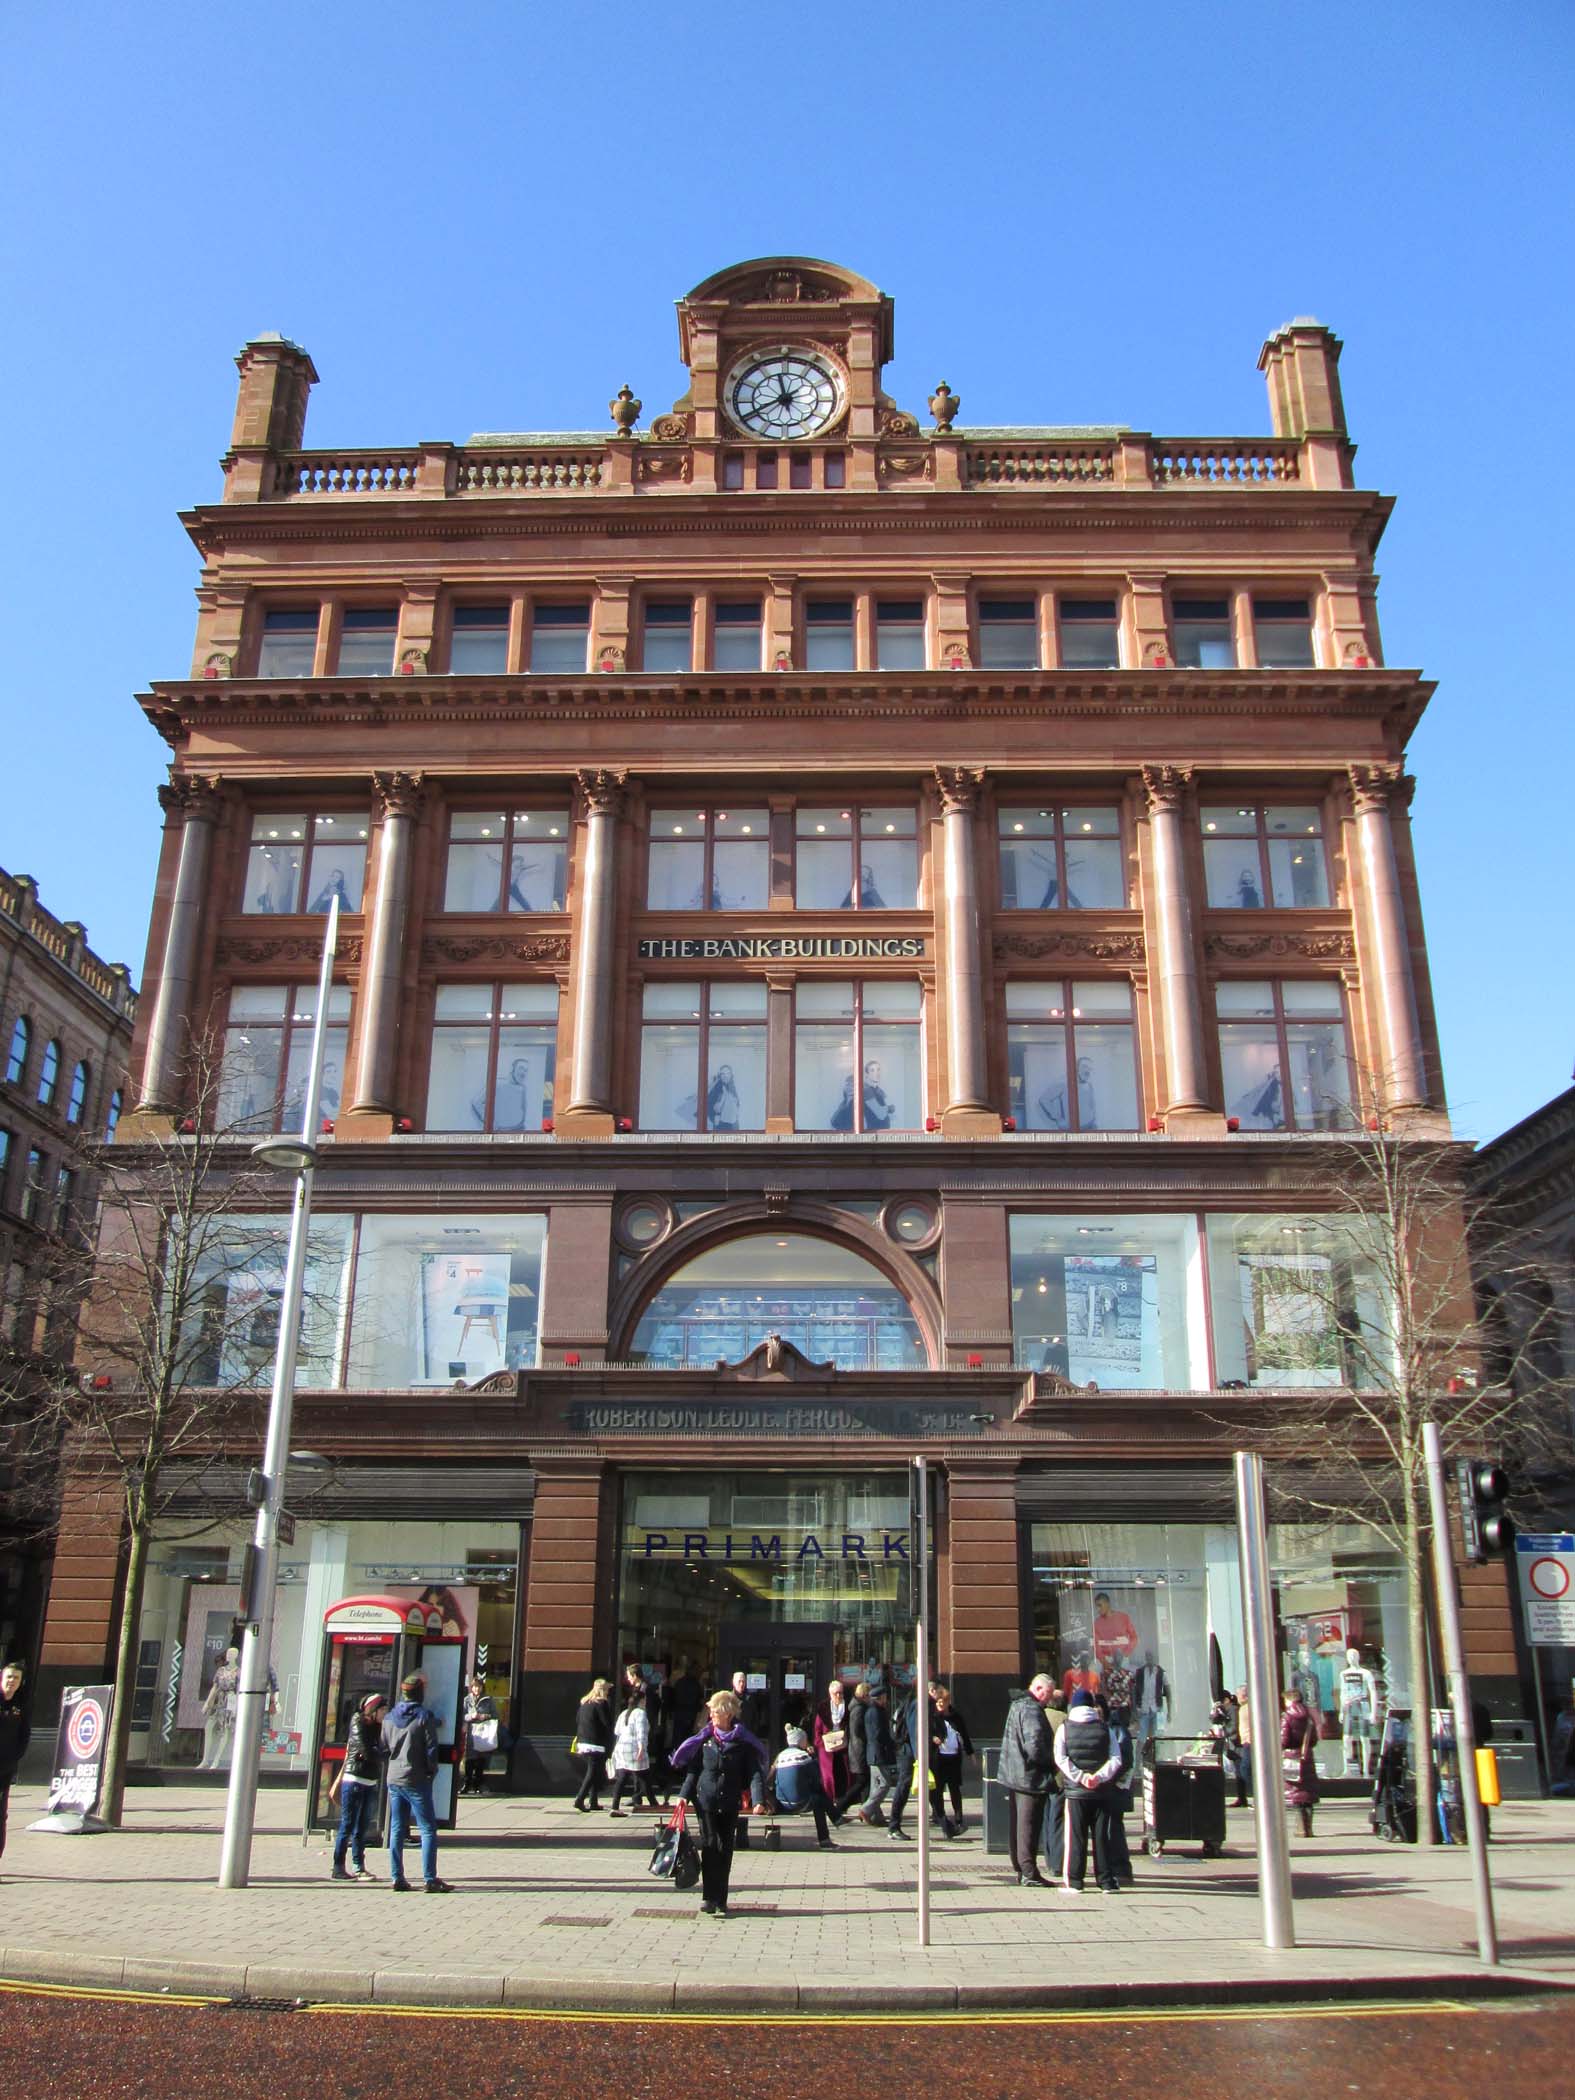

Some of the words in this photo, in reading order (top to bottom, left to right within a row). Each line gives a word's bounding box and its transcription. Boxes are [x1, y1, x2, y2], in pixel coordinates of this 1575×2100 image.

[643, 940, 695, 958] THE
[703, 940, 772, 957] BANK
[780, 939, 918, 957] BUILDINGS
[645, 1534, 909, 1559] PRIMARK
[349, 1609, 384, 1619] Telephone
[60, 1768, 75, 1777] THE
[76, 1764, 99, 1777] BEST
